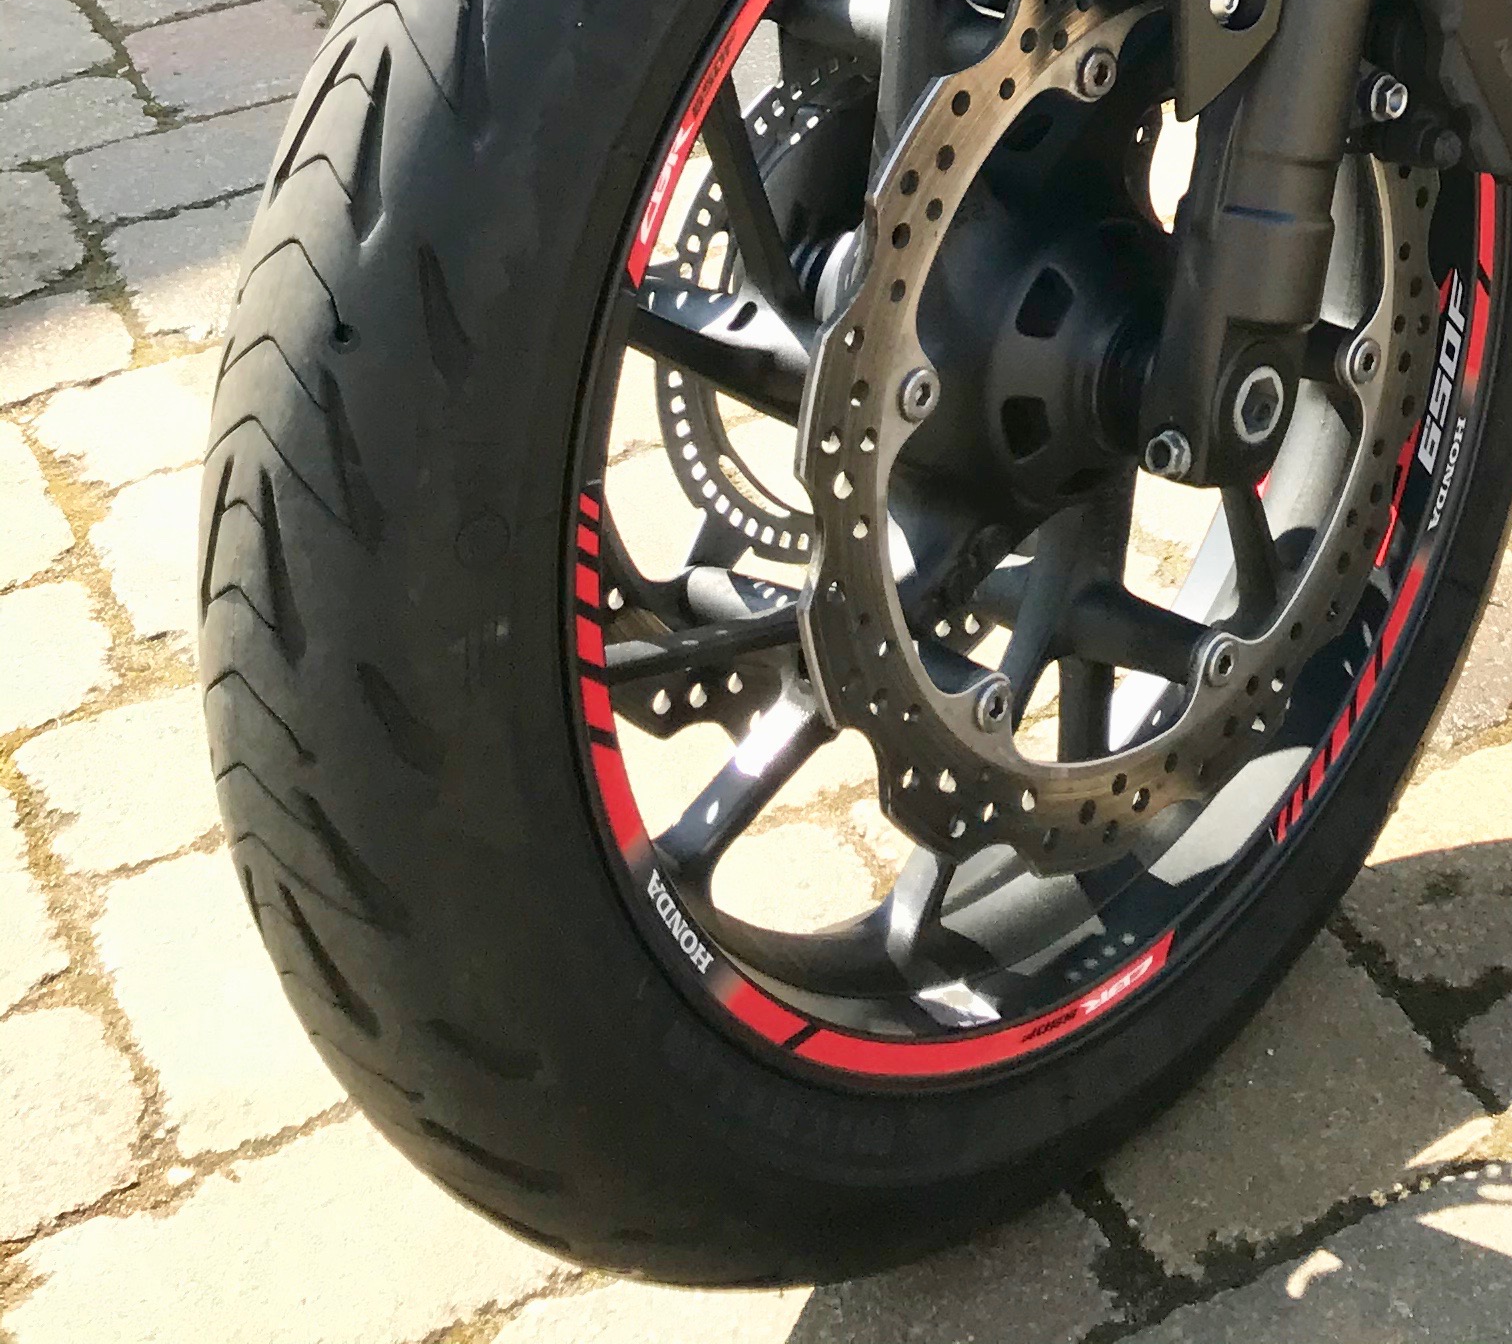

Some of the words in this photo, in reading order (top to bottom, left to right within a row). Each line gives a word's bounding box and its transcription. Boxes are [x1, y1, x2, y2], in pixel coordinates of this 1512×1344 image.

[640, 121, 696, 245] CBR
[1417, 268, 1466, 476] 650F
[1427, 416, 1467, 531] HONDA
[647, 868, 715, 974] HONDA
[1079, 955, 1154, 1015] CBR
